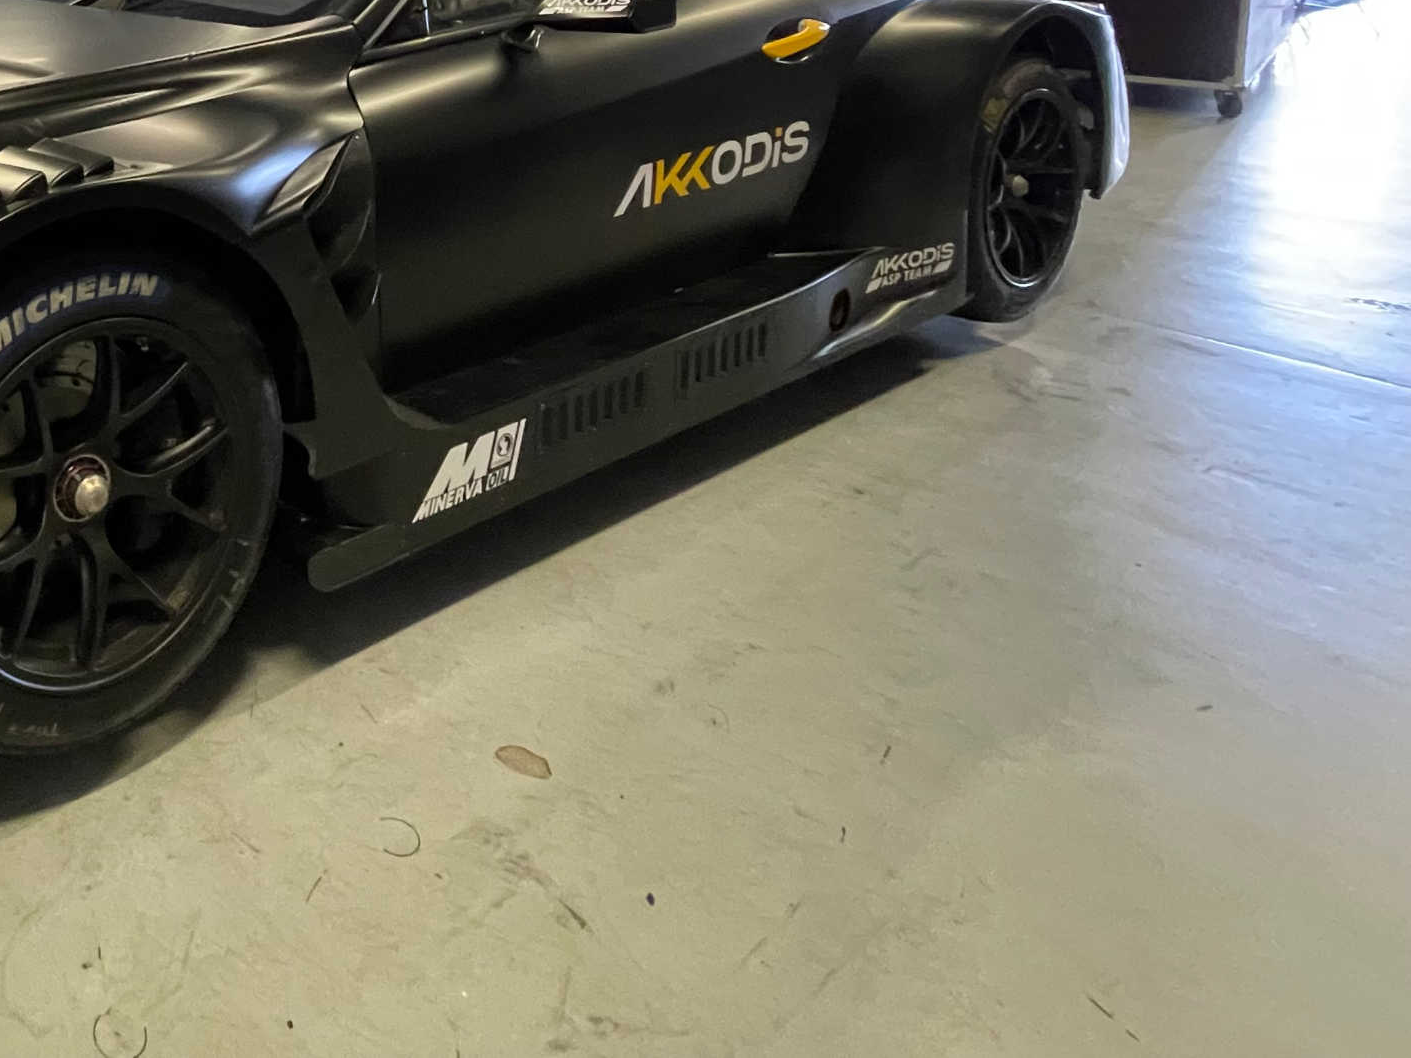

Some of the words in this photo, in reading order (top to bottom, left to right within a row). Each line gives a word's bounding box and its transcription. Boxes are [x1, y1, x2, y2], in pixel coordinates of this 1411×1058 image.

[881, 273, 902, 288] ASP
[904, 264, 932, 281] TEAM
[412, 478, 483, 523] MINERVA
[485, 465, 510, 492] OIL
